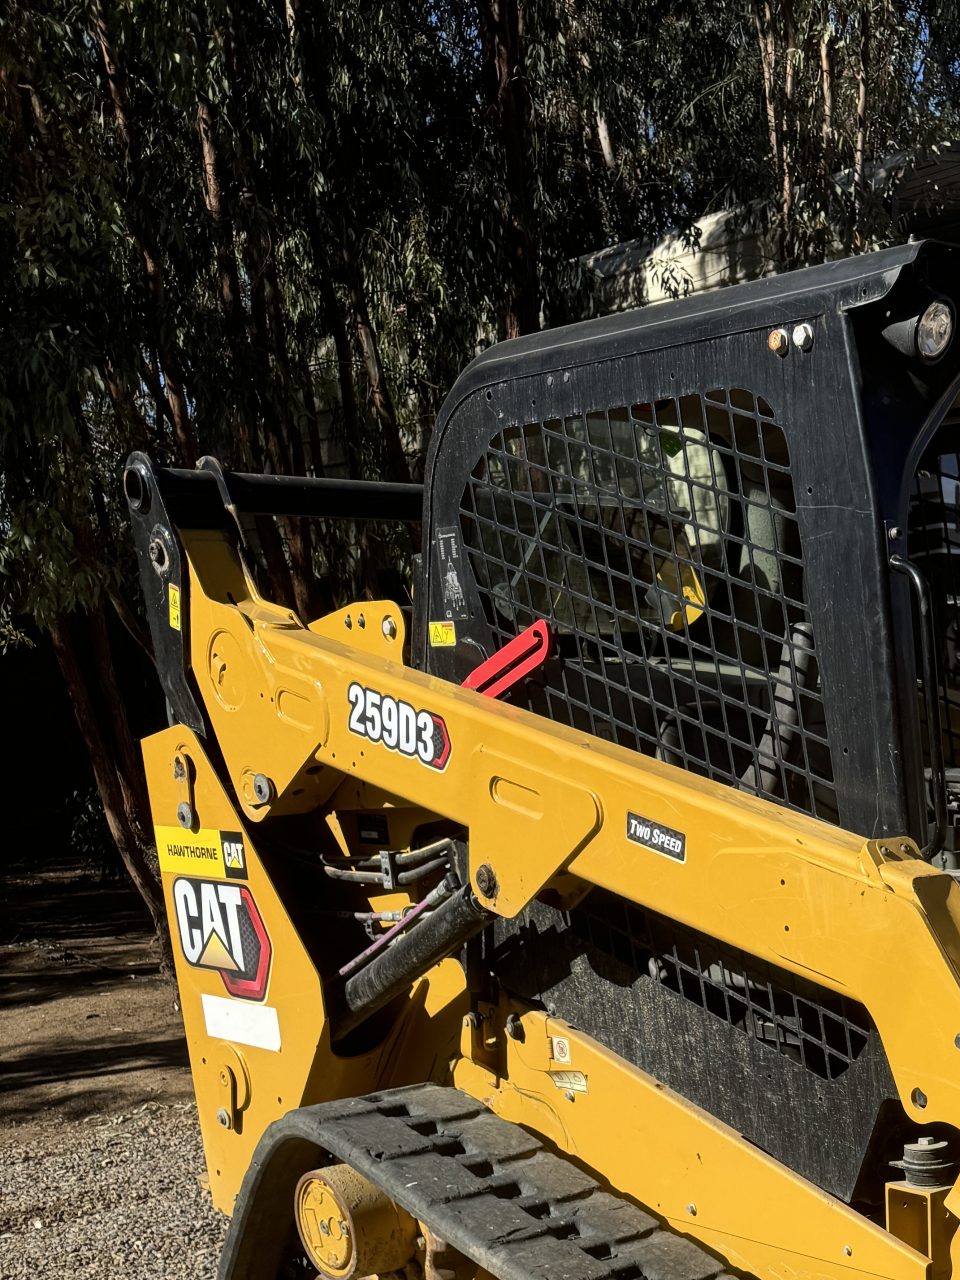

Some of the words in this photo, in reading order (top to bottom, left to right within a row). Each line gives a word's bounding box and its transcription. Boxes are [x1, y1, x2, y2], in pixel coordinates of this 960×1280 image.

[348, 684, 435, 762] 259D3
[167, 843, 218, 860] HAWTHORNE
[223, 842, 244, 869] CAT
[174, 879, 245, 972] CAT
